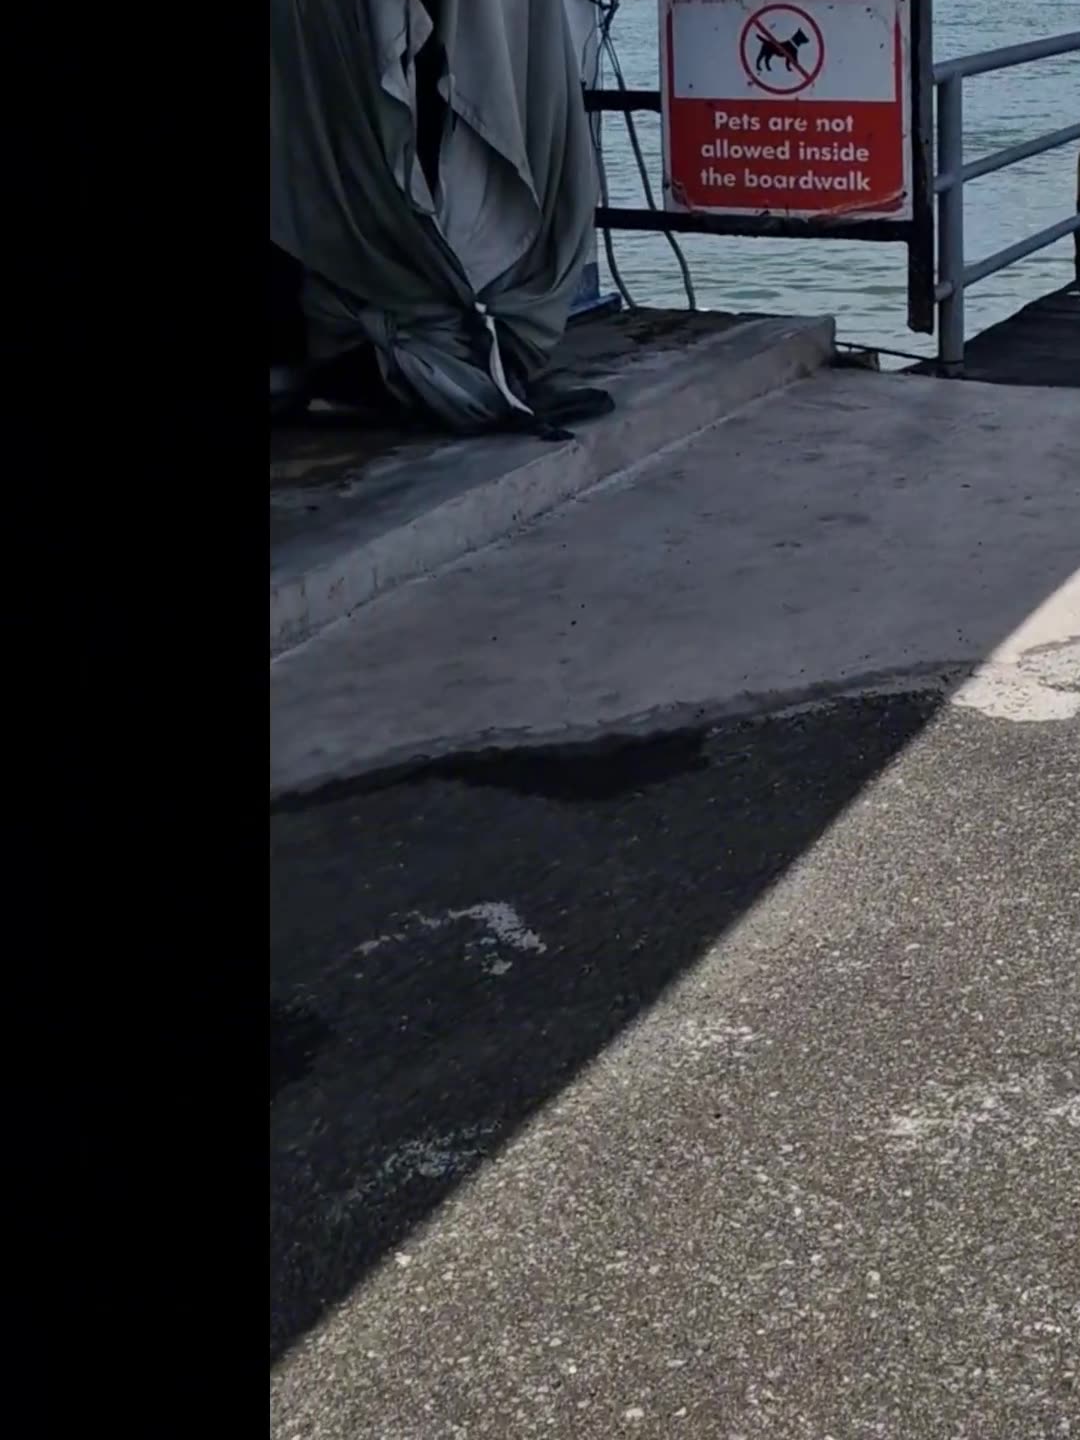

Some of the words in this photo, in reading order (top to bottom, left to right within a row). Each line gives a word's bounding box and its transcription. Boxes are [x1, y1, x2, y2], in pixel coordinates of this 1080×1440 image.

[715, 112, 761, 131] Pets
[768, 117, 808, 132] are
[816, 114, 854, 133] not
[701, 139, 790, 160] allowed
[799, 142, 870, 162] inside
[701, 167, 736, 188] the
[744, 169, 871, 191] boardwalk
